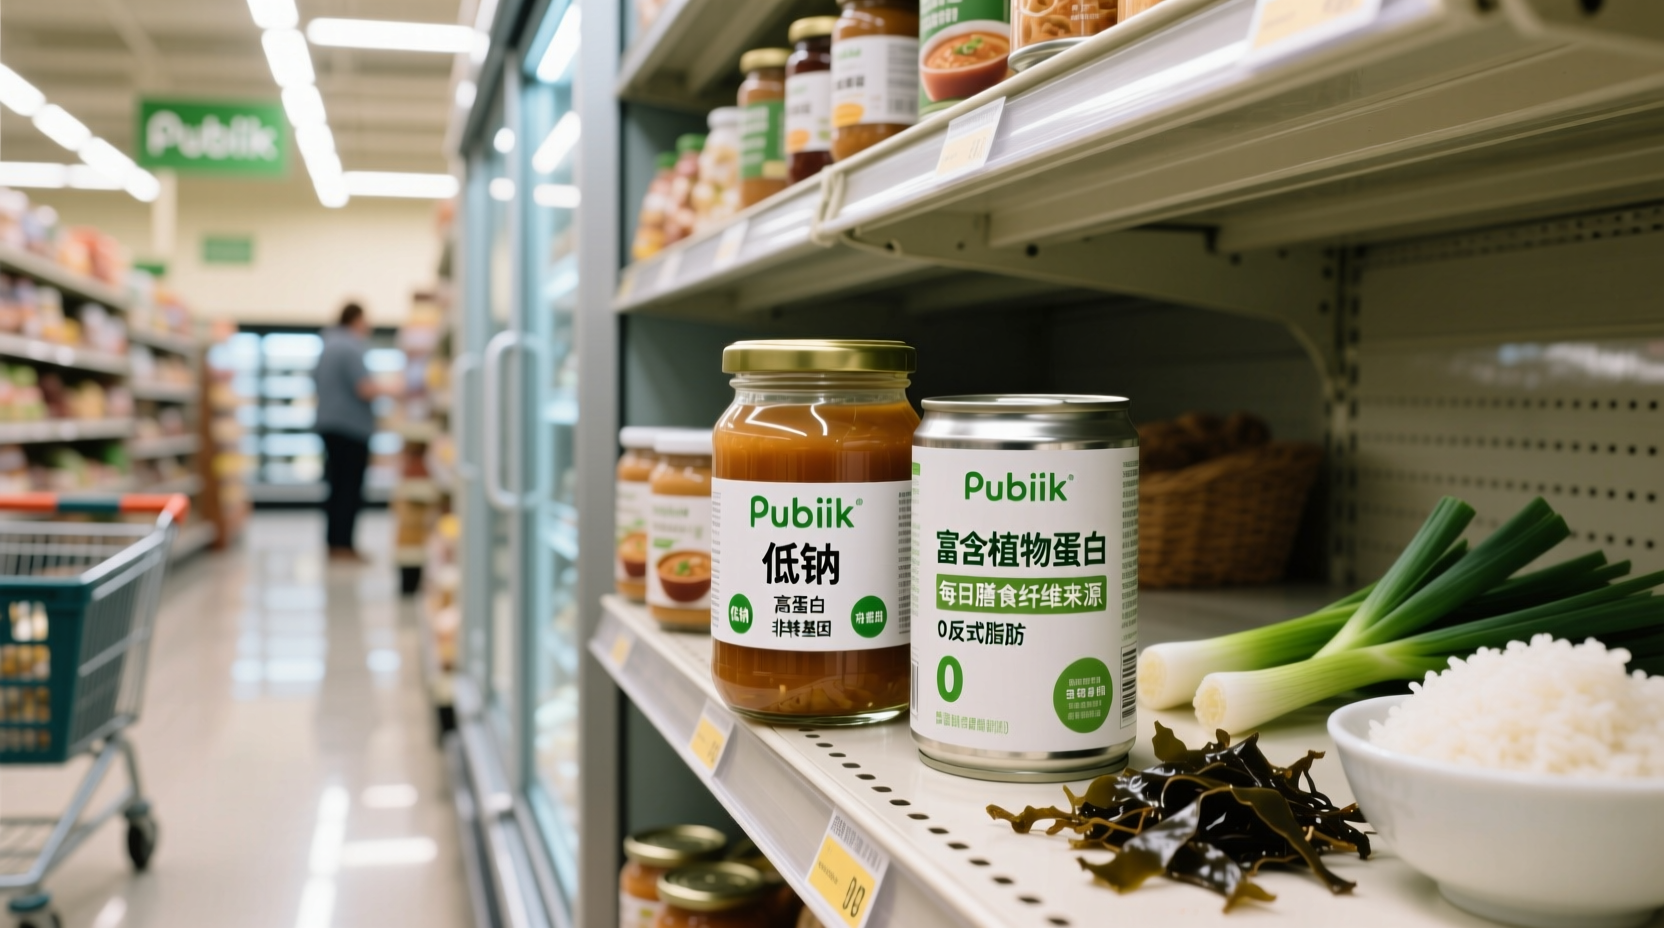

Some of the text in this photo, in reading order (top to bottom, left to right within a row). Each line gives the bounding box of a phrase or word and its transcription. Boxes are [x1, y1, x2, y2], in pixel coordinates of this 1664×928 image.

[965, 471, 1067, 502] Pubiik
[750, 495, 855, 528] Pubiik
[762, 542, 840, 585] 低钠
[936, 529, 1106, 568] 富含植物蛋白
[939, 580, 1103, 609] 每日膳食纤维来源
[937, 619, 1027, 646] 0反式脂肪
[936, 655, 964, 703] 0
